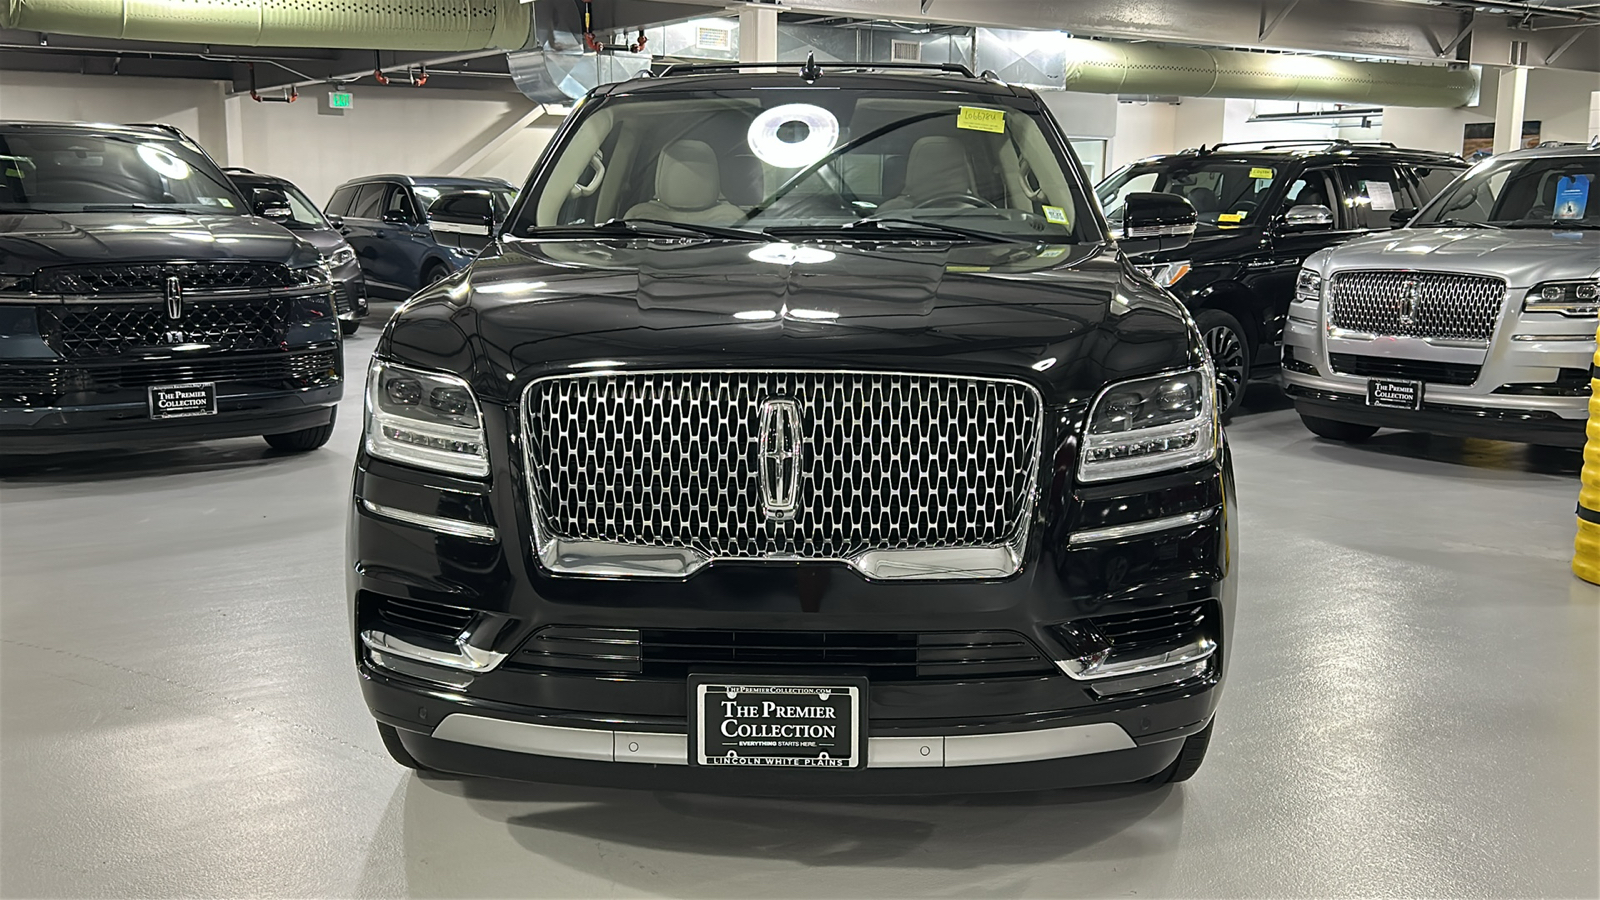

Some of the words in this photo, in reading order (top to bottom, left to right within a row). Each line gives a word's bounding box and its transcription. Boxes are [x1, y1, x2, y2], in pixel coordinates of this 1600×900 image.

[1375, 383, 1388, 391] THE
[1389, 384, 1413, 393] PREMIER
[175, 391, 206, 399] PREMIER
[1374, 390, 1413, 399] COLLECTION
[158, 399, 206, 408] COLLECTION
[721, 701, 759, 718] THE
[762, 701, 836, 718] PREMIER
[720, 719, 836, 738] COLLECTION
[713, 757, 761, 765] LINCOLN
[766, 757, 800, 766] WHITE
[804, 758, 843, 766] PLAINS
